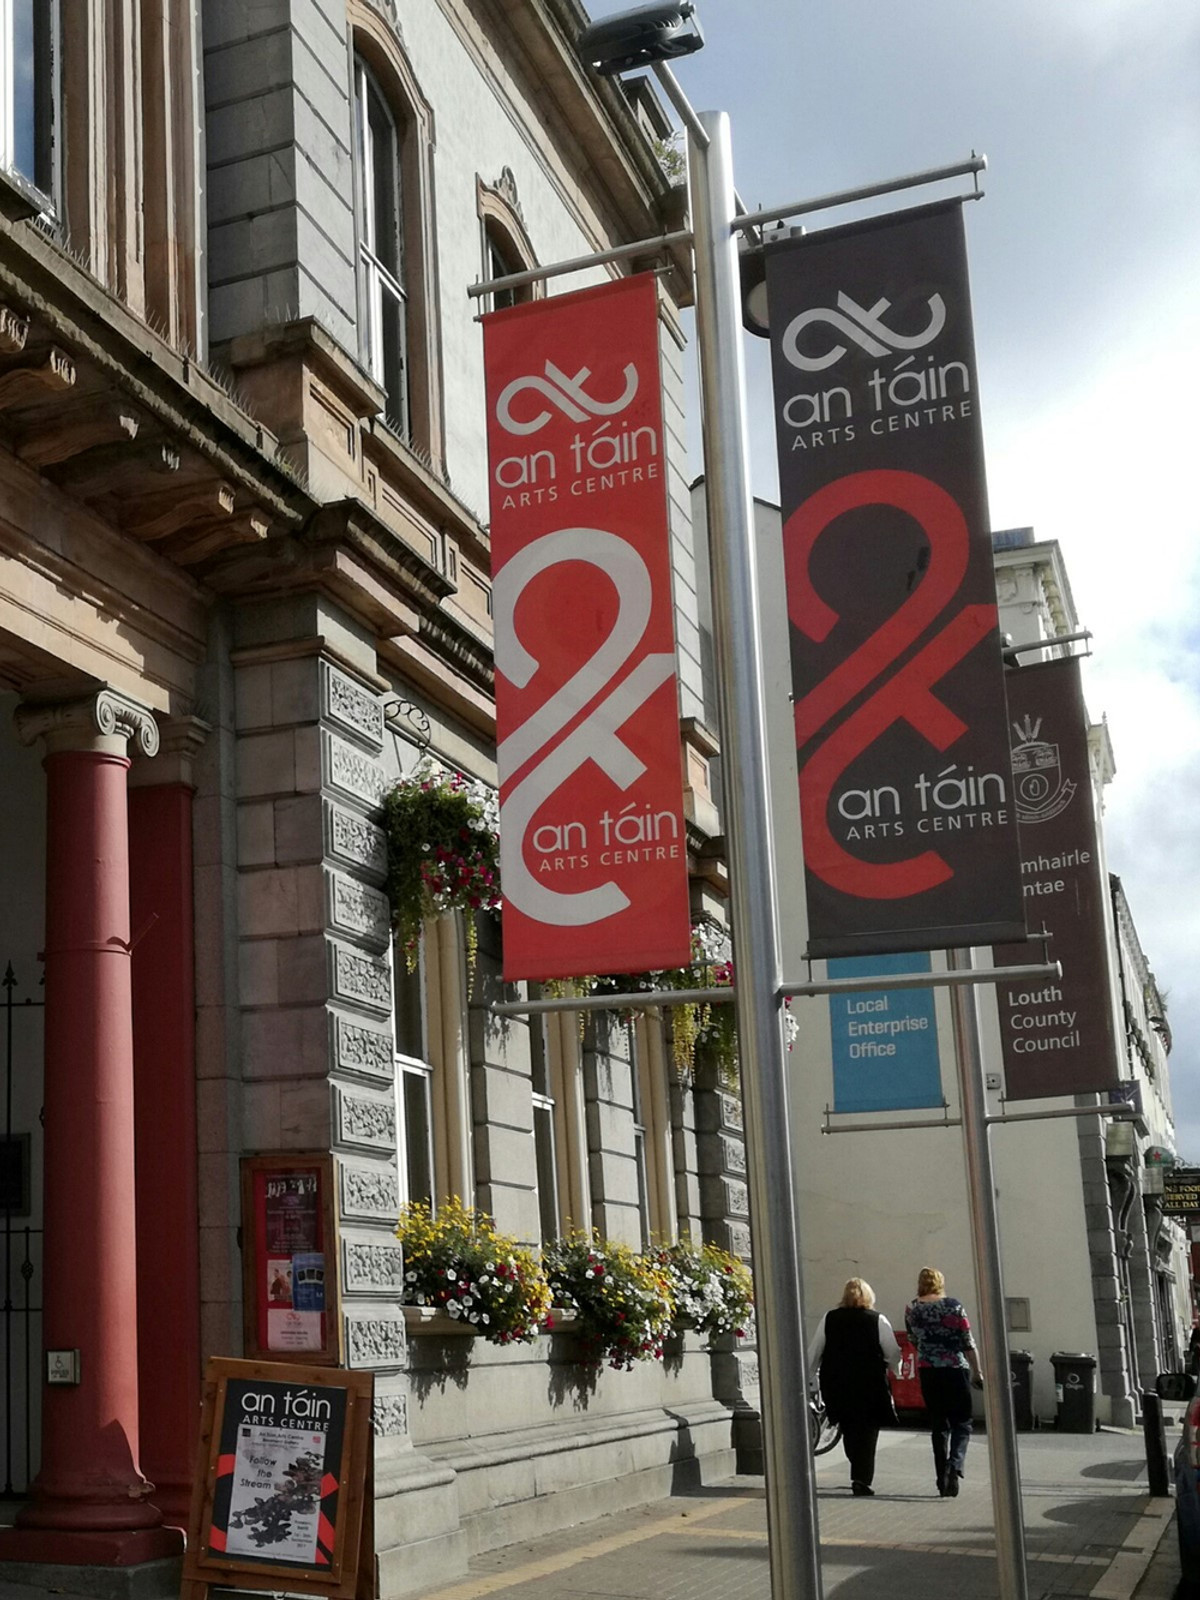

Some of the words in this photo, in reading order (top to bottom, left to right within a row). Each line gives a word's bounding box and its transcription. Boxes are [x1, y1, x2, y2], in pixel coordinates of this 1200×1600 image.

[783, 386, 852, 428] an
[867, 355, 970, 411] táin
[791, 425, 856, 451] ARTS
[870, 400, 972, 435] CENTRE
[495, 450, 556, 488] an
[570, 420, 657, 474] táin
[502, 486, 558, 510] ARTS
[570, 463, 658, 496] CENTRE
[838, 786, 900, 820] an
[914, 764, 1006, 812] táin
[532, 821, 587, 853] an
[599, 802, 678, 846] táin
[846, 821, 904, 840] ARTS
[917, 810, 1008, 833] CENTRE
[539, 854, 589, 872] ARTS
[600, 845, 680, 866] CENTRE
[847, 996, 888, 1014] Local
[1008, 986, 1062, 1007] Louth
[848, 1016, 928, 1037] Enterprise
[1010, 1010, 1077, 1031] County
[849, 1041, 896, 1059] Office
[1012, 1030, 1080, 1053] Council
[241, 1392, 275, 1414] an
[283, 1389, 331, 1419] táin
[242, 1414, 274, 1426] ARTS
[280, 1418, 330, 1432] CENTRE
[249, 1455, 277, 1466] Follow
[240, 1478, 271, 1489] Stream
[257, 1469, 272, 1478] the
